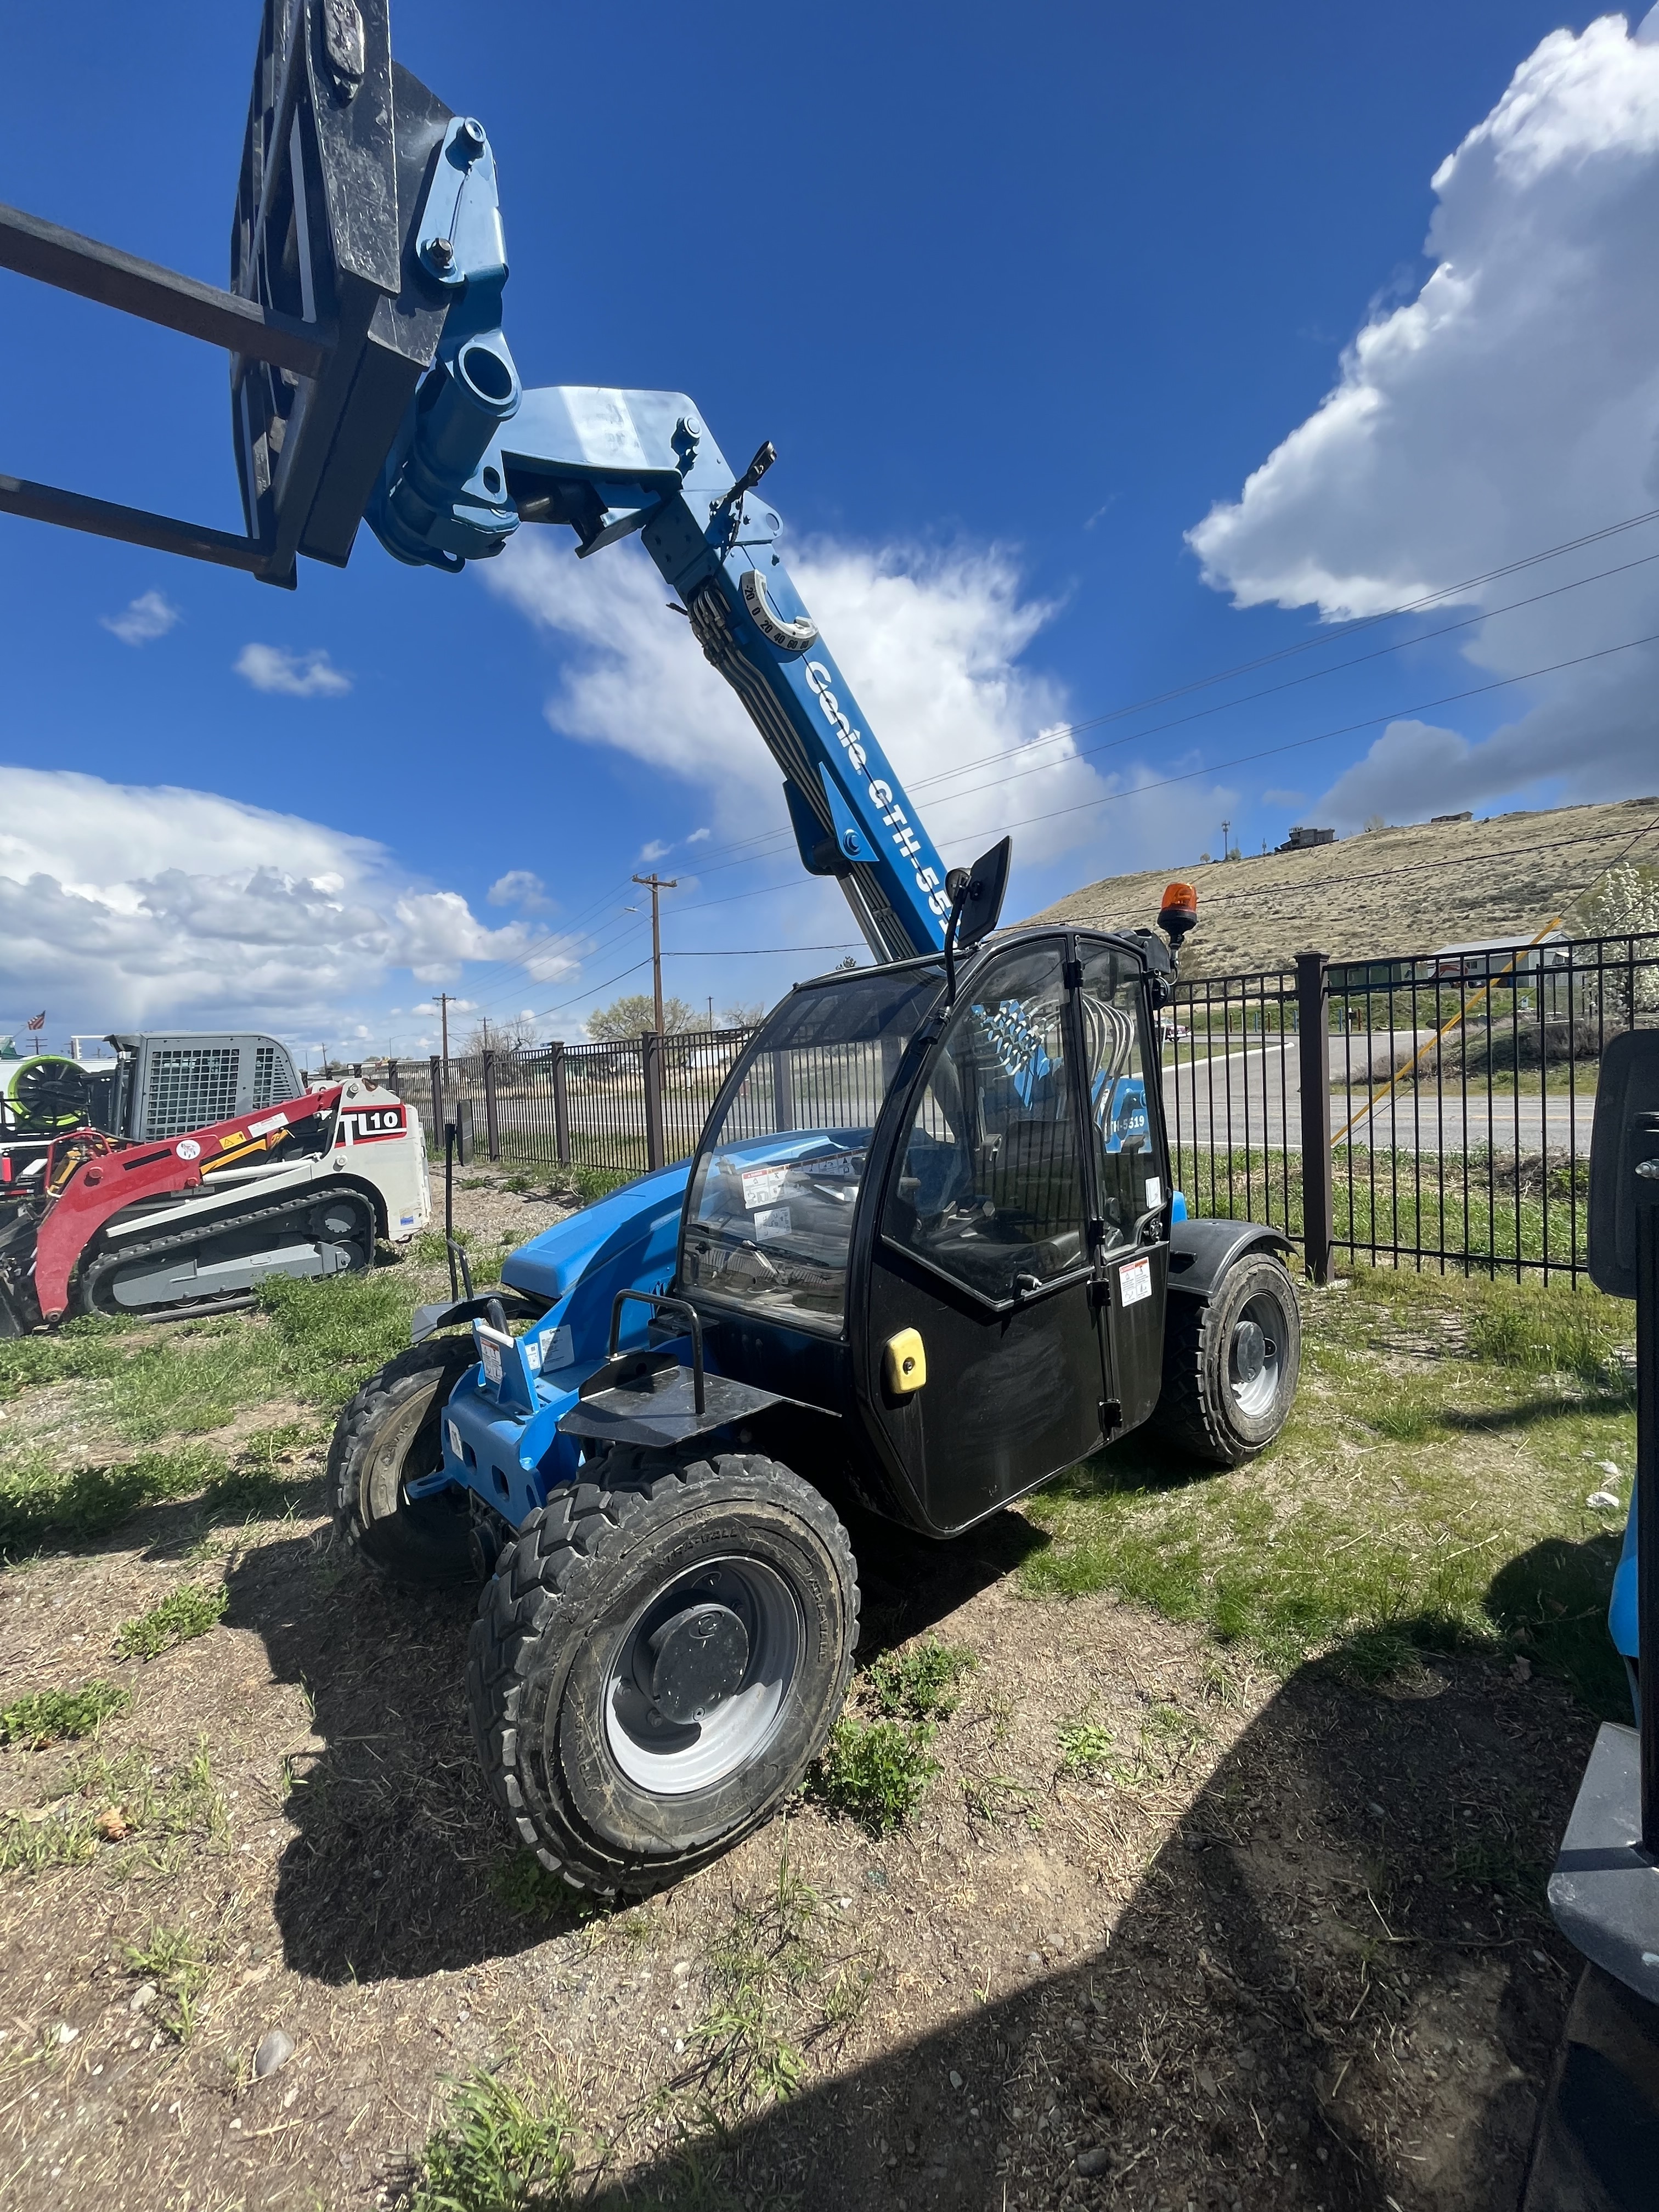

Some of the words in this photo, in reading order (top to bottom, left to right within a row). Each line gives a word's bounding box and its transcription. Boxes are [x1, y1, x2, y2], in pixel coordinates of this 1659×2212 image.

[744, 585, 755, 601] -20
[752, 607, 761, 616] 0
[760, 620, 773, 634] 20
[774, 633, 786, 644] 40
[787, 639, 798, 649] 60
[805, 661, 868, 771] Genie
